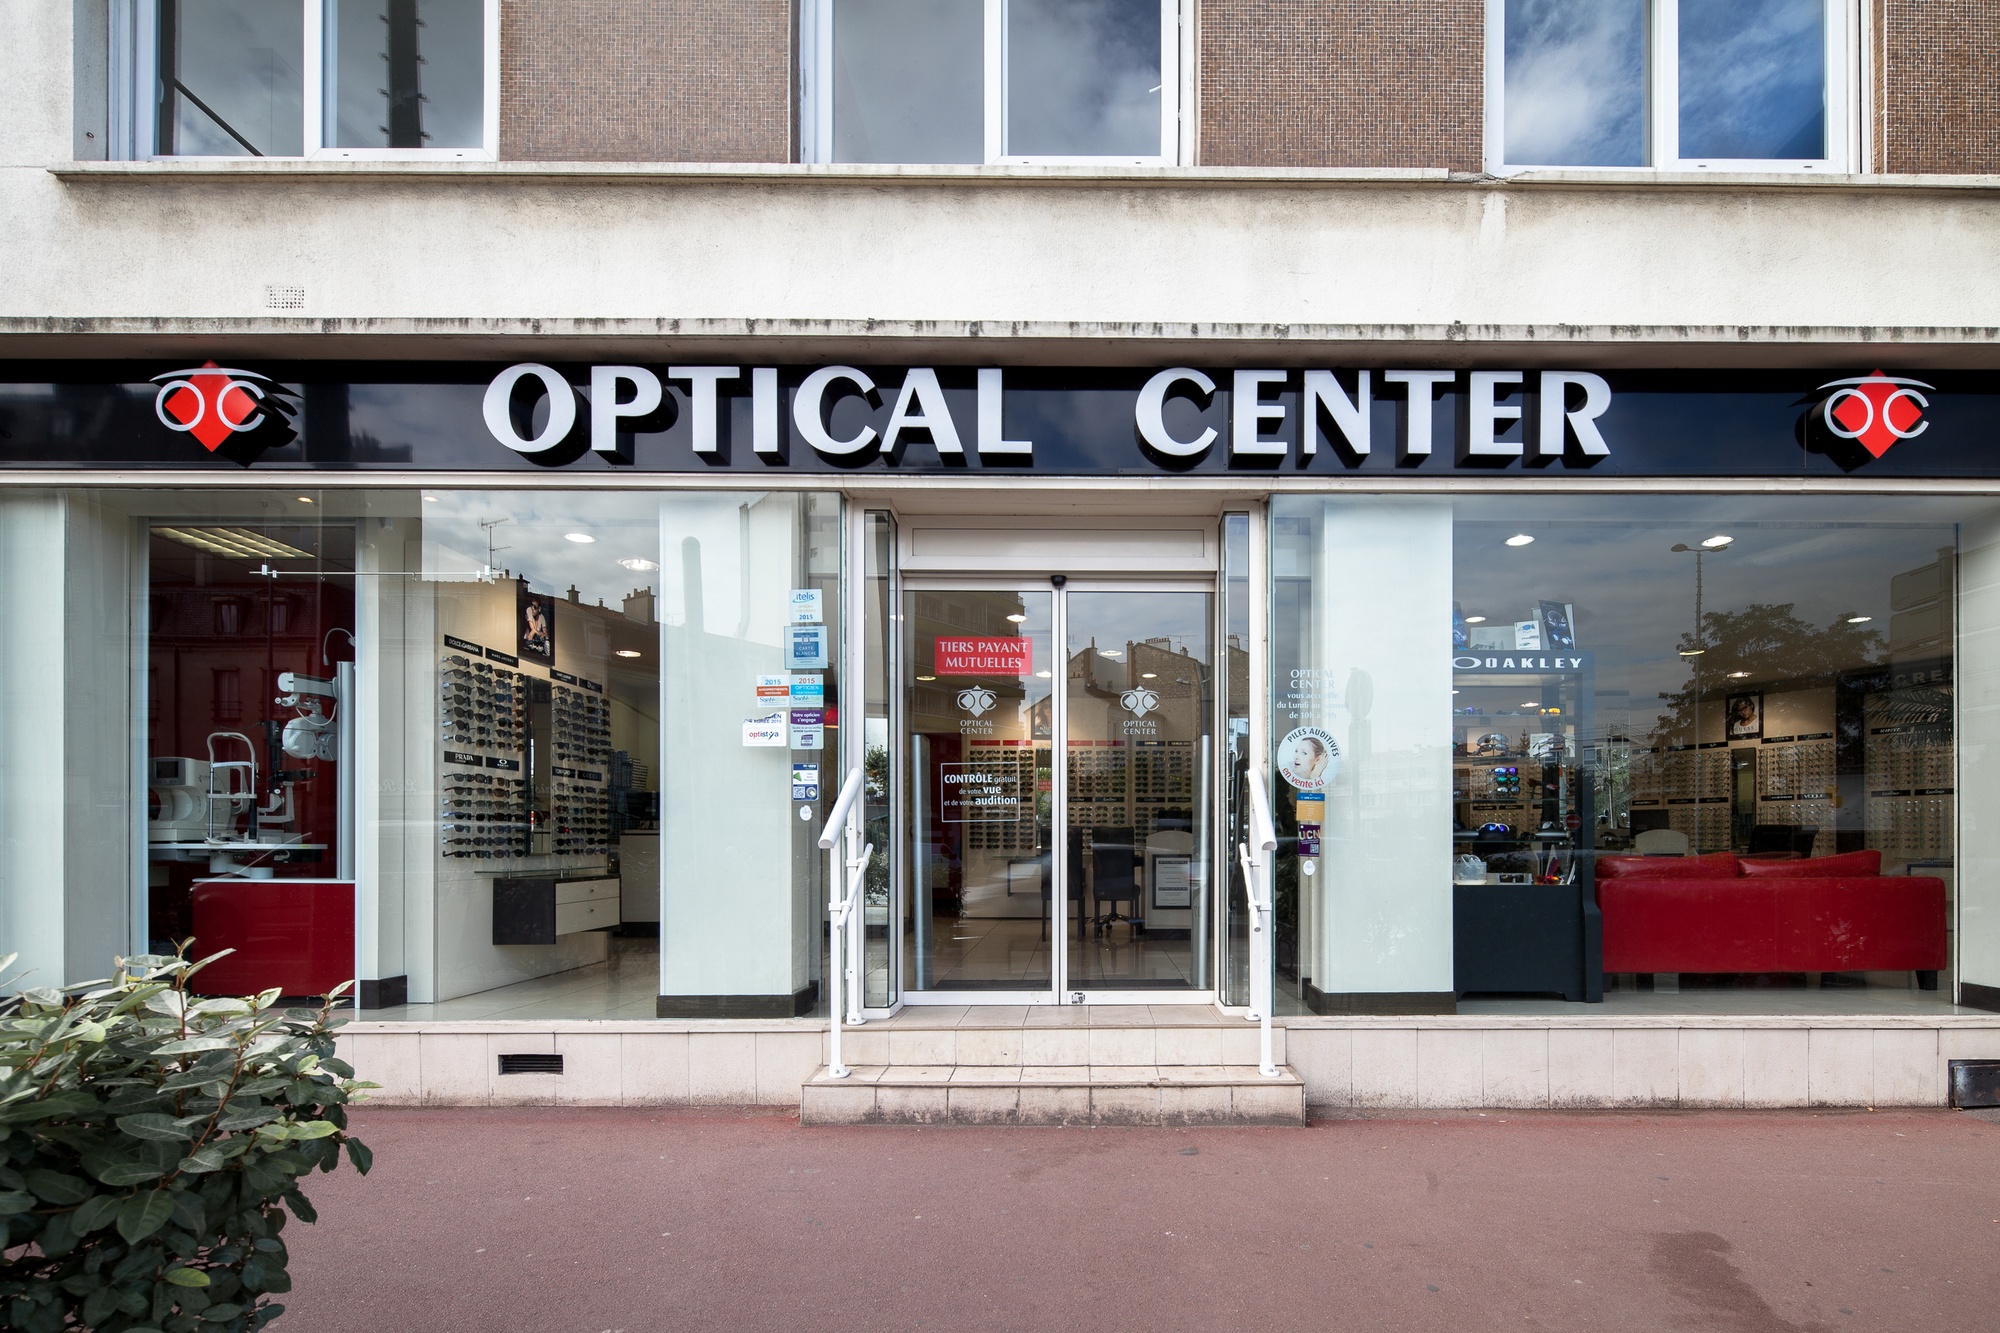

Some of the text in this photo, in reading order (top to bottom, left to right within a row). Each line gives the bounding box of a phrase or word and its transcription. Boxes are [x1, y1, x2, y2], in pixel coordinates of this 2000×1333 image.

[482, 362, 1612, 457] OPTICAL CENTER
[796, 592, 815, 601] itelis
[939, 641, 1028, 653] TIERS PAYANT
[945, 656, 1022, 669] MUTUELLES
[1485, 657, 1583, 669] OAKLEY
[1276, 701, 1287, 709] du
[1288, 701, 1309, 709] Lundi
[1288, 711, 1299, 719] de
[959, 719, 993, 727] OPTICAL
[960, 727, 993, 735] CENTER
[1287, 727, 1340, 757] PILES AUDITIVES
[454, 753, 474, 762] PRADA
[944, 771, 1017, 785] CONTRÔLE gratuit
[1282, 767, 1325, 789] en vente ici
[983, 786, 1002, 794] vue
[975, 795, 1017, 805] audition
